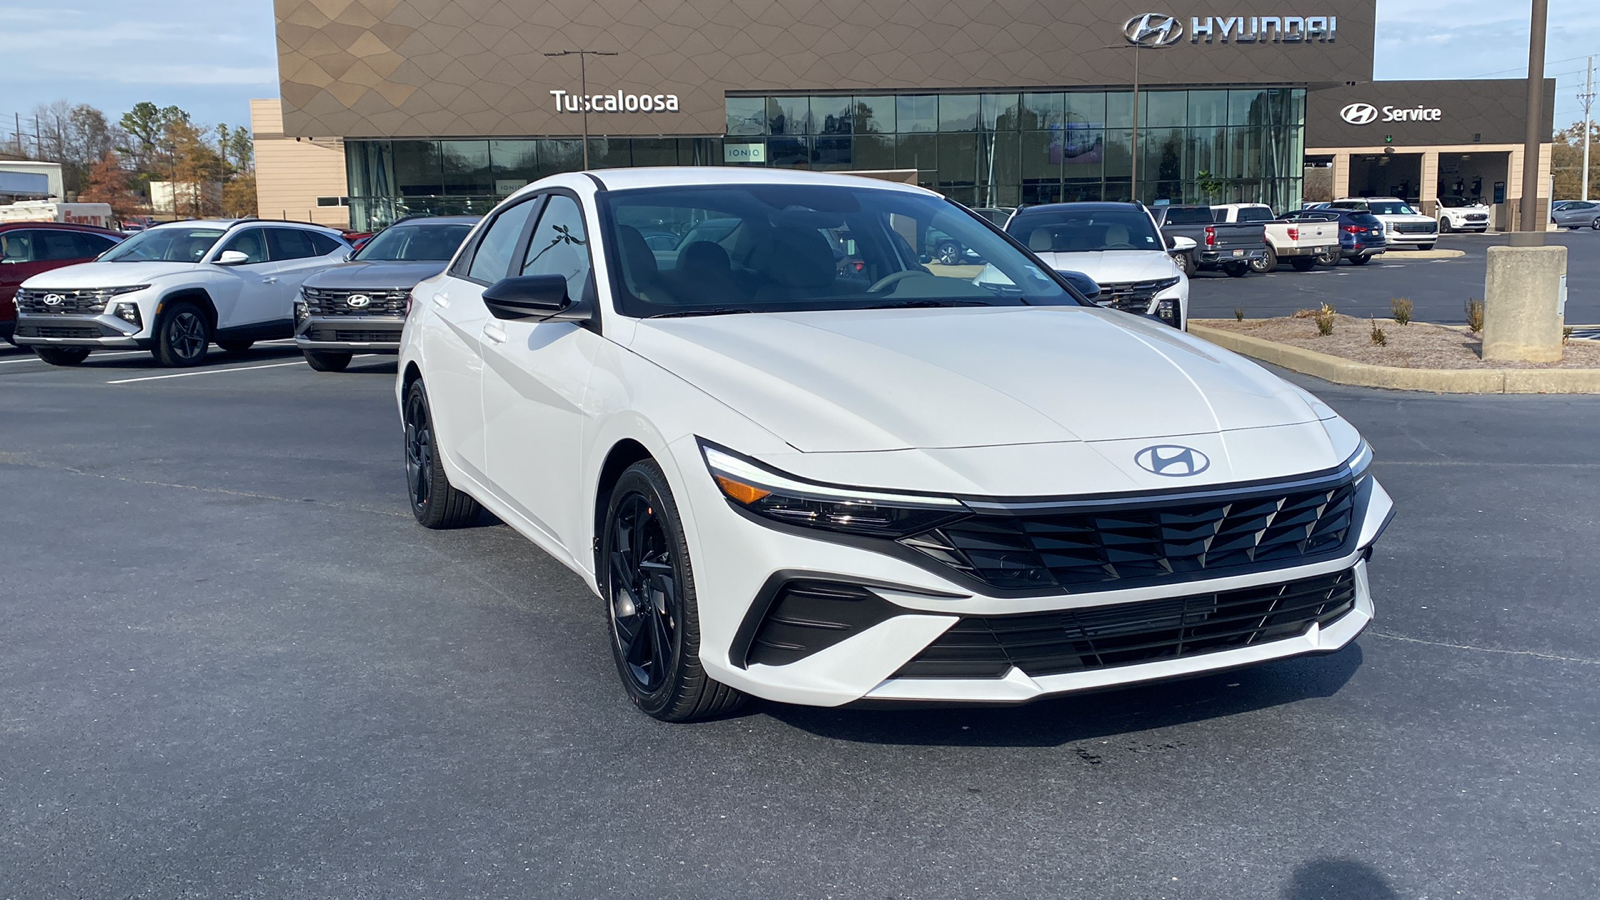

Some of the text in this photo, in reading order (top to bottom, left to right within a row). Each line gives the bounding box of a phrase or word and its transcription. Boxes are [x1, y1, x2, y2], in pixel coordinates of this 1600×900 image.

[1190, 16, 1337, 42] HYUNDAI
[549, 89, 679, 112] Tuscaloosa
[1381, 104, 1442, 122] Service
[729, 149, 760, 157] IONIQ
